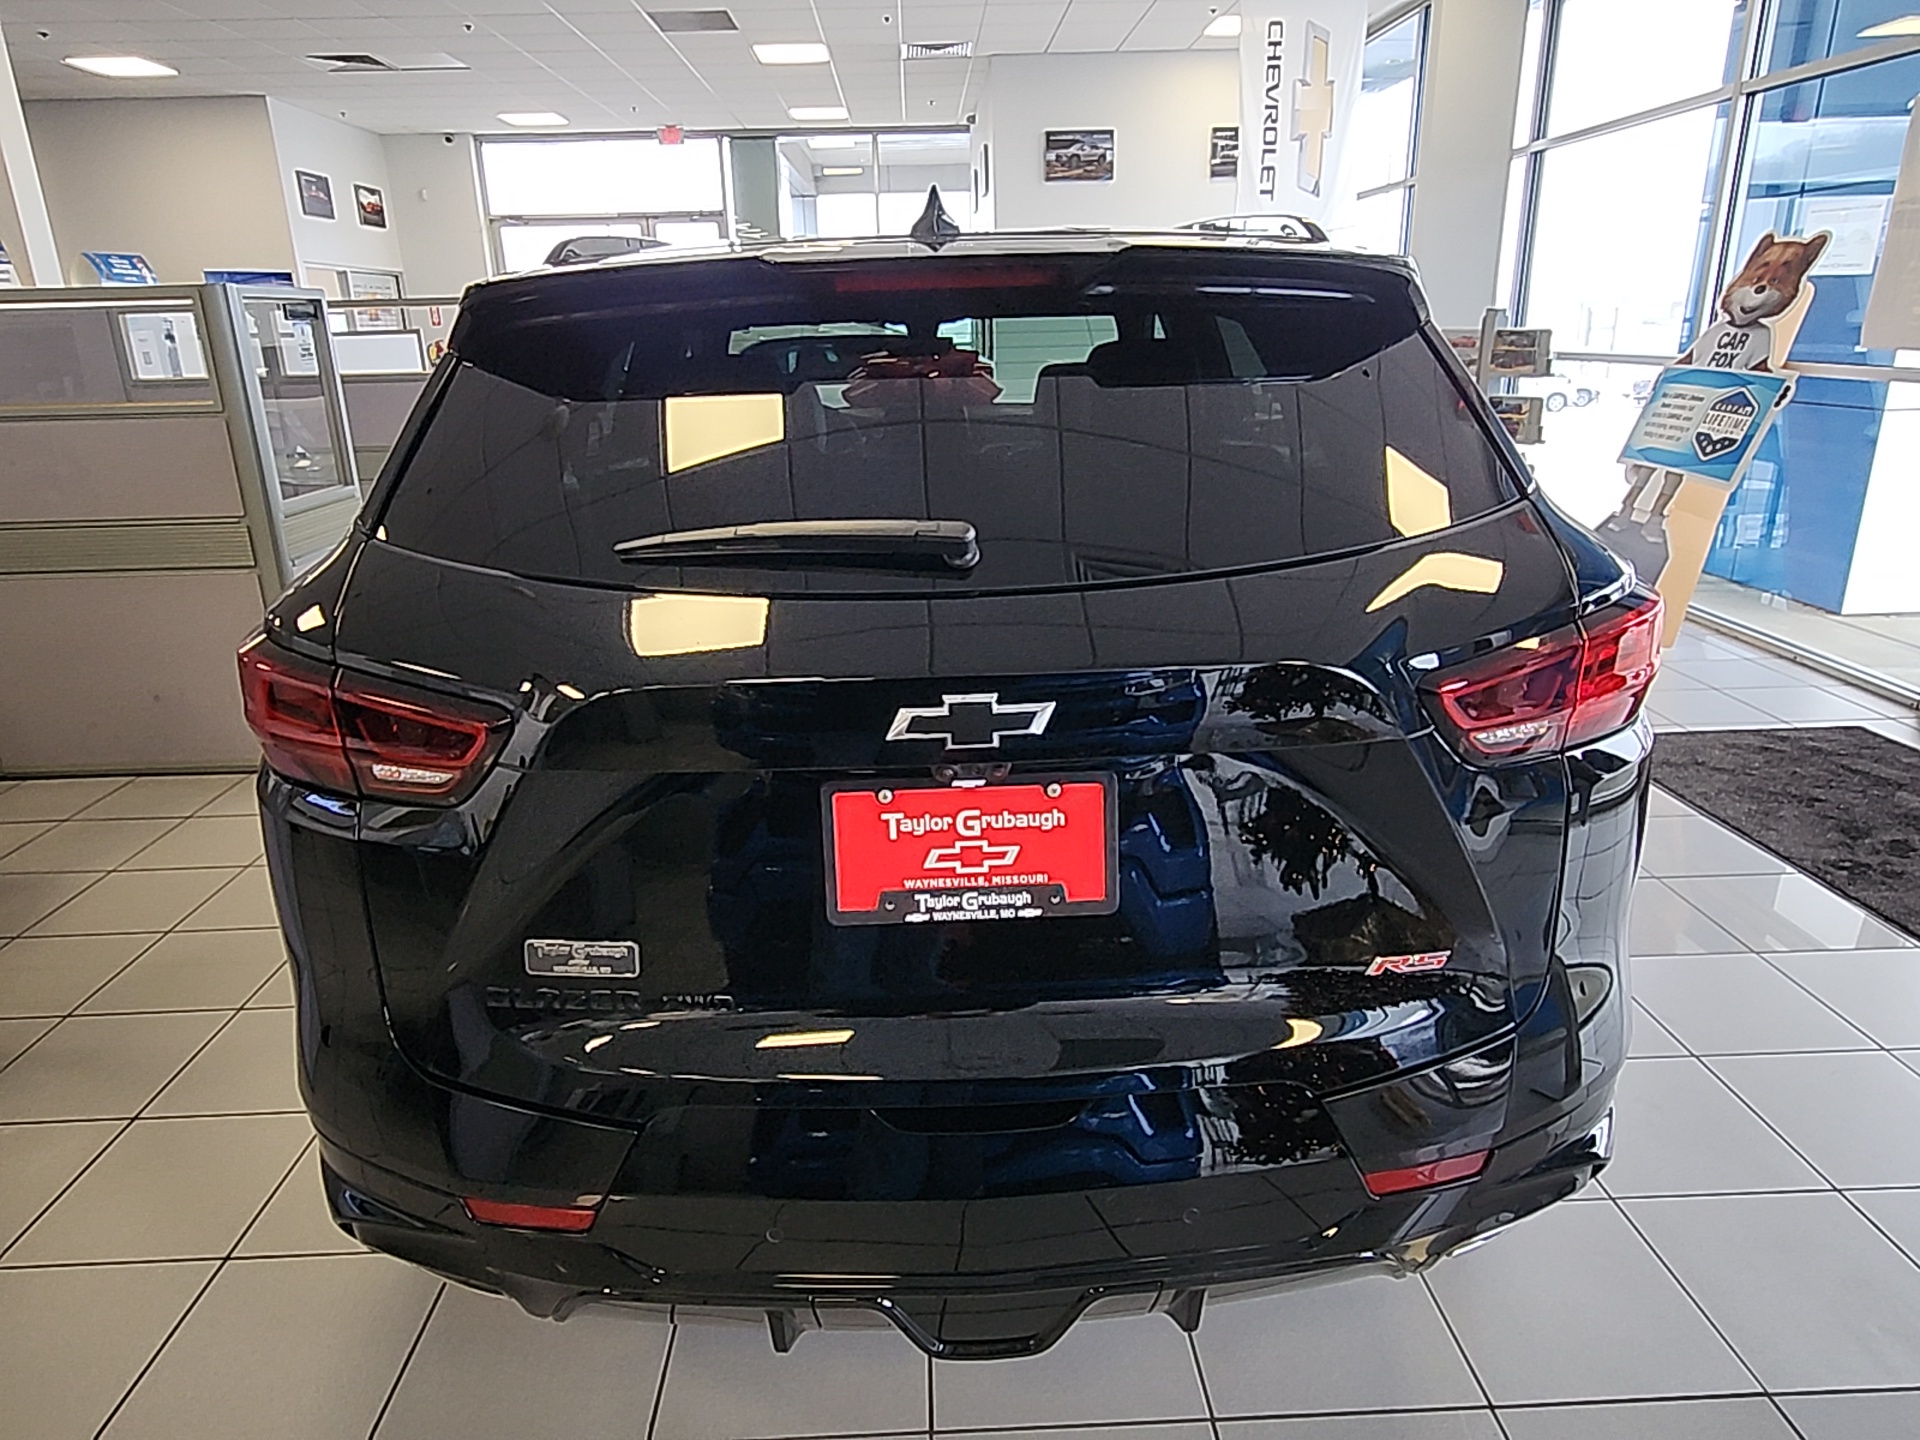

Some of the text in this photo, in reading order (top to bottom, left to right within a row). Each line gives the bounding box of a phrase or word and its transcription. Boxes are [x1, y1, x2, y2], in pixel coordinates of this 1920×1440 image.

[1259, 20, 1283, 201] CHEVROLET
[1716, 331, 1750, 351] CAR
[1706, 351, 1741, 369] FOX
[880, 808, 1066, 841] Taylor Grubaugh
[903, 873, 1049, 889] WAYNESVILLE, MISSOURI
[914, 891, 1032, 912] Taylor Grubaugh
[932, 908, 1016, 922] WAYNESVILLE, MO
[1364, 950, 1451, 976] RS
